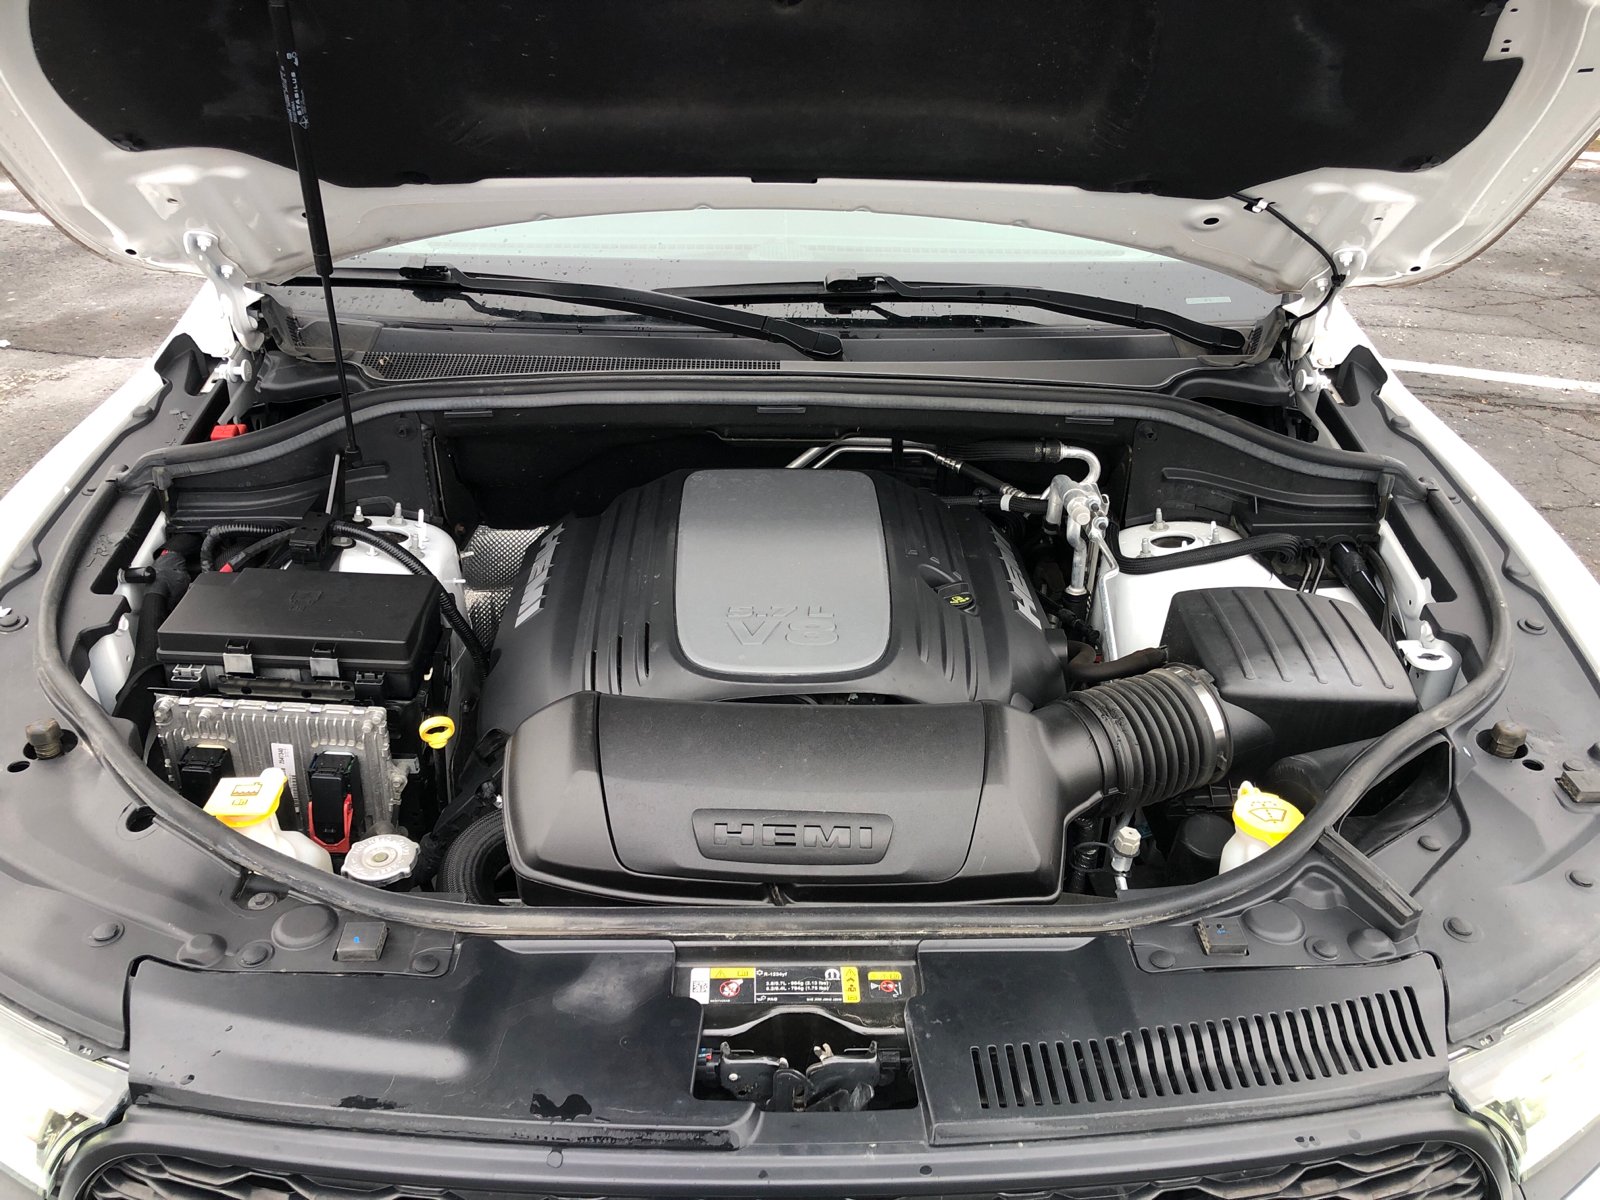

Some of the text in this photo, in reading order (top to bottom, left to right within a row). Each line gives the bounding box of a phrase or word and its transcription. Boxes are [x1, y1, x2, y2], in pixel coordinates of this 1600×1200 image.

[290, 71, 302, 116] STABILUS
[514, 522, 565, 629] HEMI
[725, 620, 840, 646] V8
[713, 822, 873, 849] HEMI
